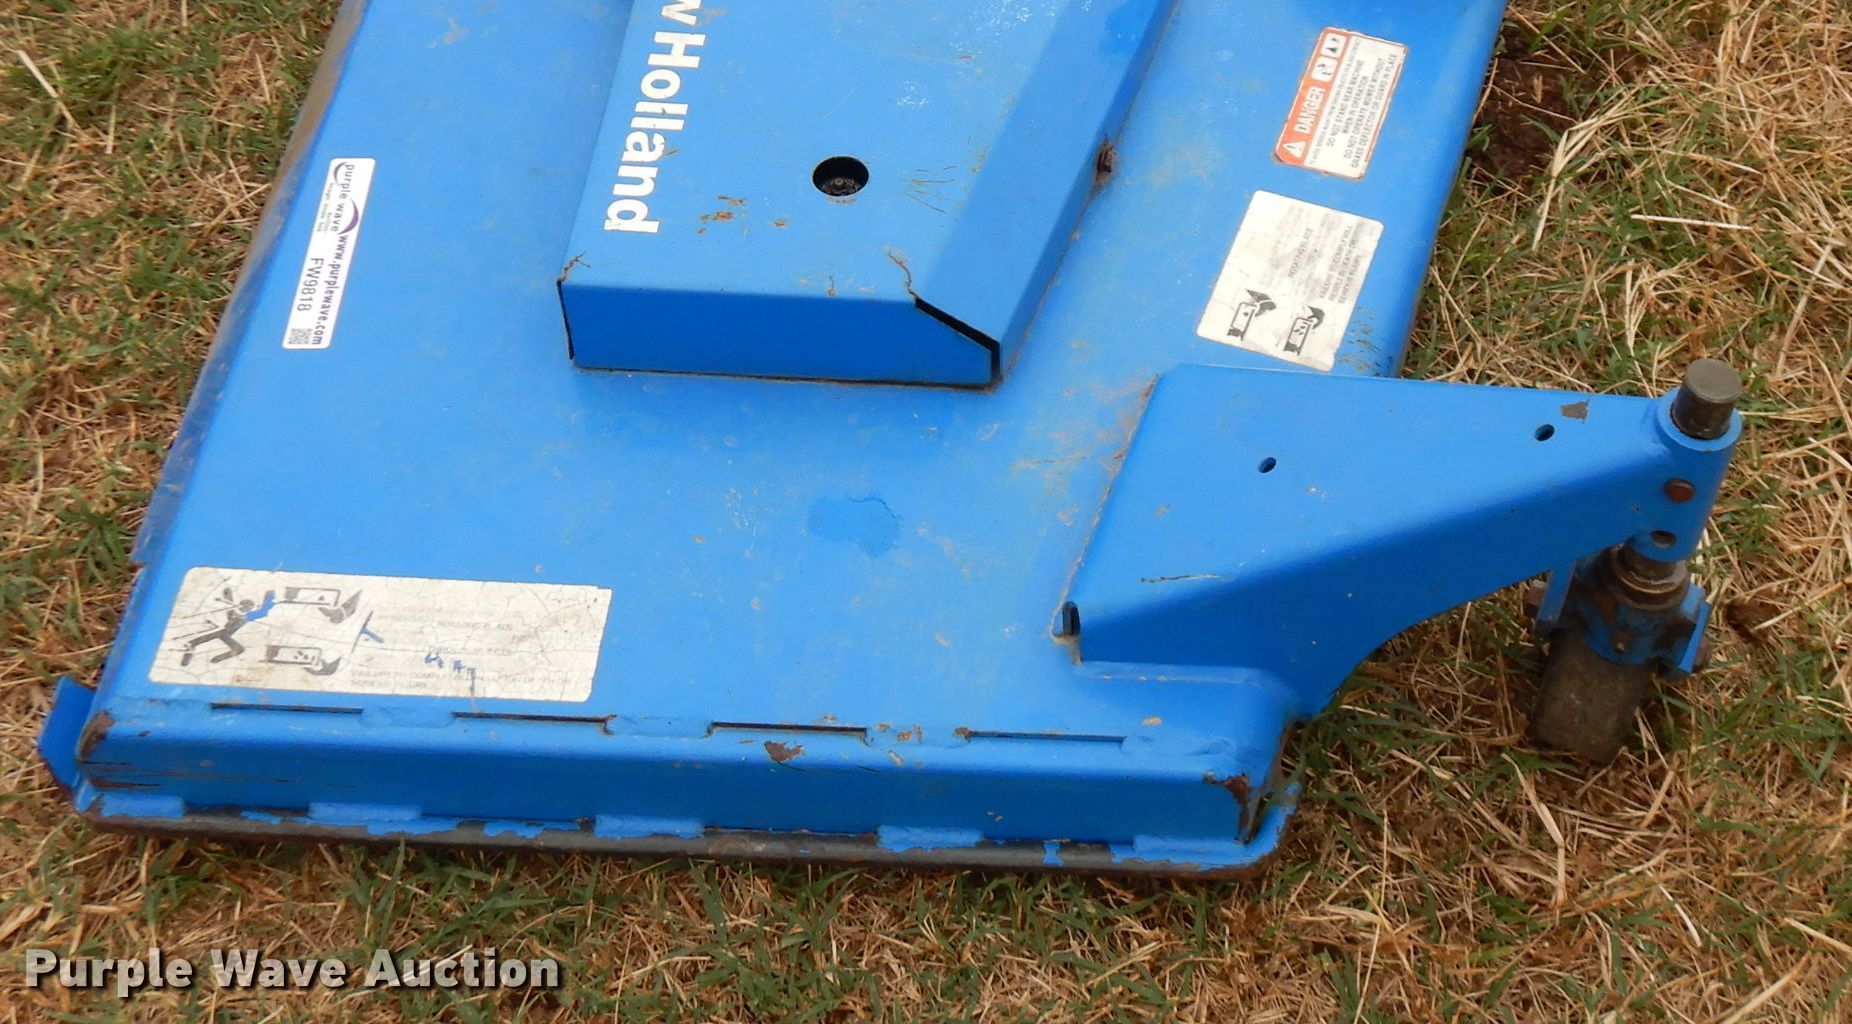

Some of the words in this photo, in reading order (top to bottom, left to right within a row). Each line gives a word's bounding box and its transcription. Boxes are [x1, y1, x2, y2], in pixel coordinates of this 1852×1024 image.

[603, 31, 706, 233] Holland
[1294, 87, 1326, 134] DANGER
[339, 164, 355, 198] purple
[331, 203, 344, 231] wave
[296, 257, 324, 311] FW9818
[311, 235, 348, 344] www.purplewave.com
